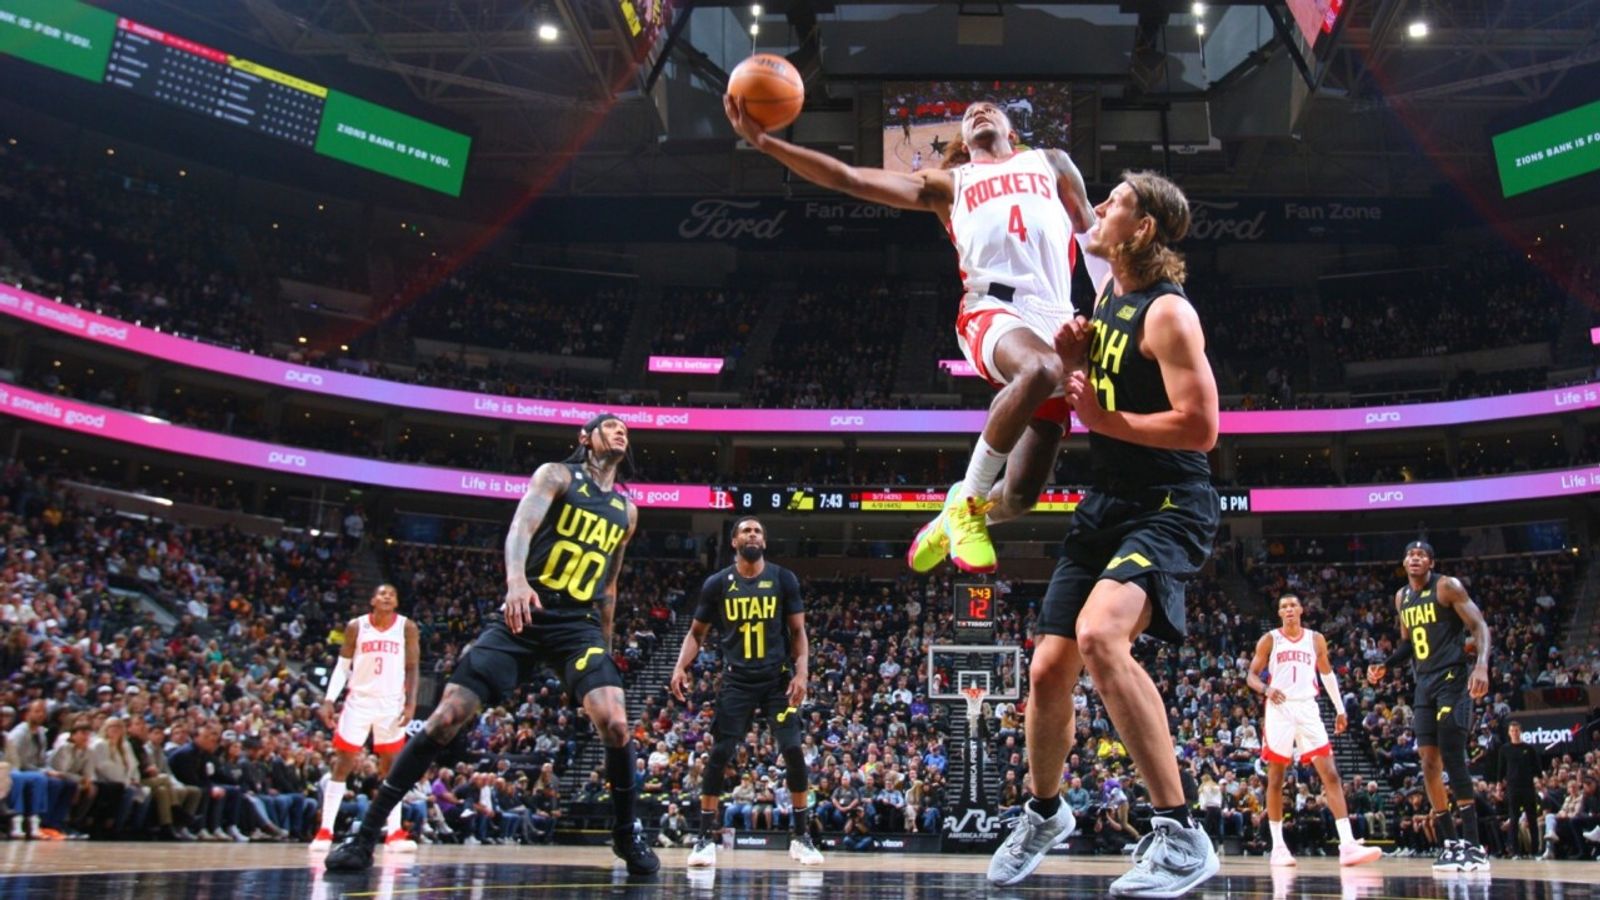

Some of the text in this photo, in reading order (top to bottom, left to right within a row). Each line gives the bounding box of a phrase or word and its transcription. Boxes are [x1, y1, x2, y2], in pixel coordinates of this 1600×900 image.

[337, 123, 451, 168] ZIONS BANK IS FOR YOU.
[1515, 150, 1544, 168] ZIONS
[1546, 141, 1573, 158] BANK
[1575, 137, 1585, 148] IS
[964, 172, 1051, 214] ROCKETS
[678, 199, 788, 240] Ford
[804, 202, 901, 219] Fan Zone
[1284, 203, 1381, 220] Fan Zone
[1008, 204, 1027, 243] 4
[87, 321, 128, 340] good
[286, 370, 323, 386] pura
[1554, 389, 1597, 406] Life is
[64, 410, 105, 428] good
[474, 398, 499, 412] Life
[502, 401, 513, 414] is
[516, 403, 558, 417] better
[561, 407, 597, 420] when
[656, 413, 689, 426] good
[831, 415, 864, 426] pura
[1366, 411, 1401, 424] pura
[269, 452, 306, 467] pura
[461, 475, 487, 490] Life
[489, 478, 501, 492] is
[647, 489, 680, 504] good
[1561, 475, 1586, 489] Life
[743, 493, 781, 508] 8 9
[820, 494, 843, 508] 7:43
[1220, 496, 1248, 511] 6 PM
[1368, 491, 1404, 504] pura
[557, 503, 625, 556] UTAH
[538, 540, 606, 601] 00
[968, 587, 991, 600] 7:43
[724, 595, 777, 621] UTAH
[970, 599, 988, 619] 12
[1401, 602, 1437, 629] UTAH
[361, 640, 400, 655] ROCKETS
[739, 621, 765, 659] 11
[1412, 626, 1429, 660] 8
[374, 656, 384, 675] 3
[1276, 650, 1311, 666] ROCKETS
[1292, 665, 1297, 684] 1
[1520, 726, 1574, 745] erizon
[969, 739, 978, 803] AMERICA FIRST
